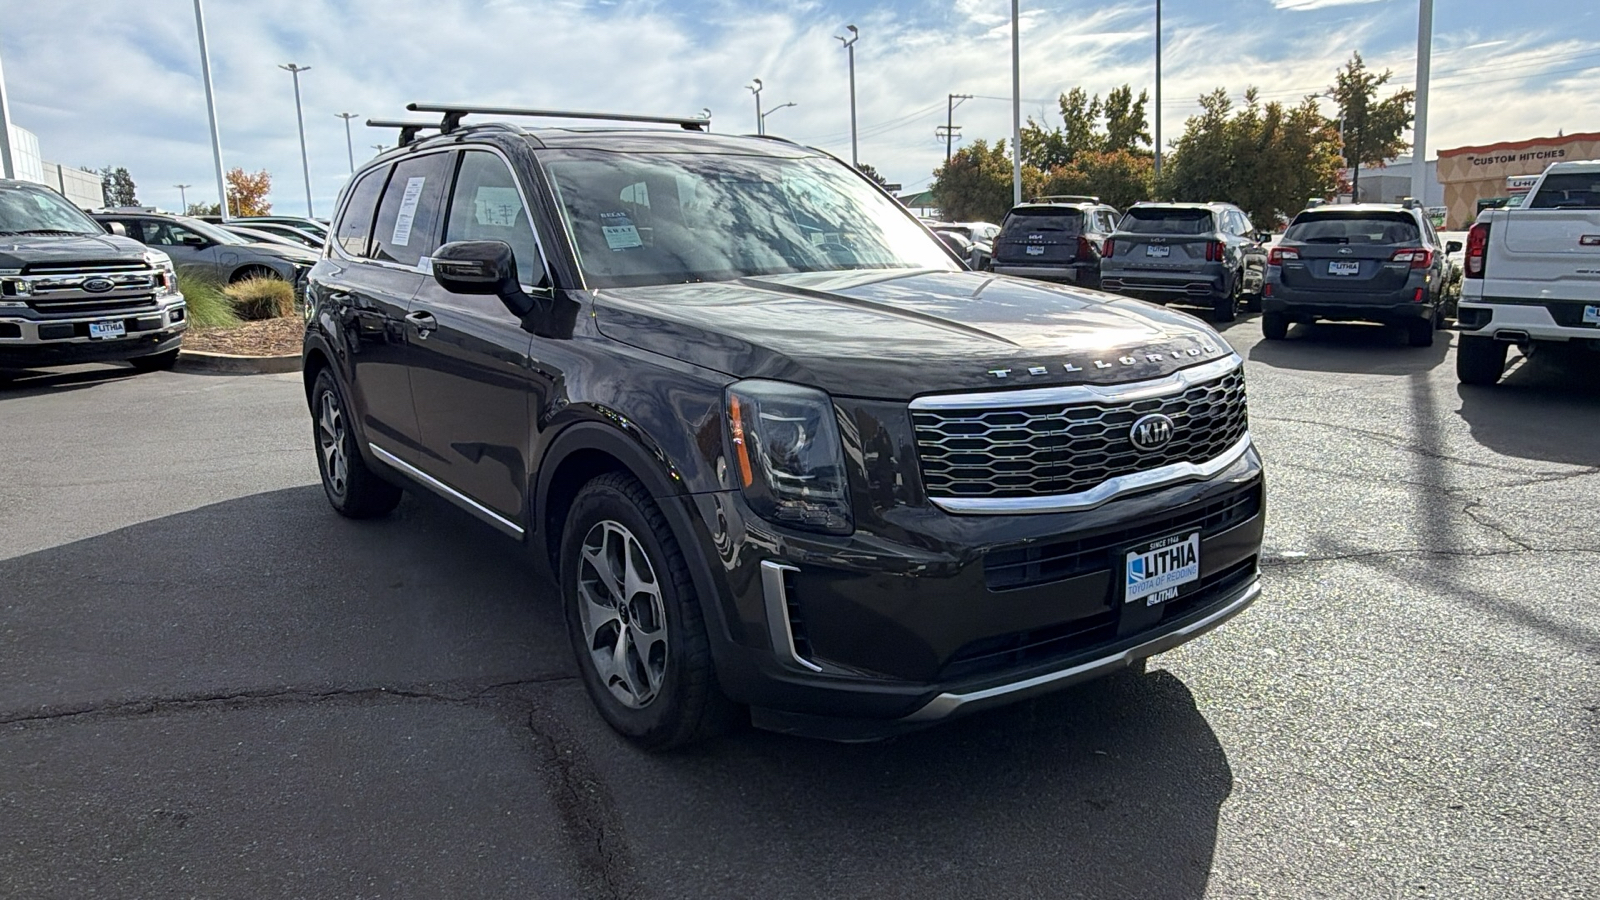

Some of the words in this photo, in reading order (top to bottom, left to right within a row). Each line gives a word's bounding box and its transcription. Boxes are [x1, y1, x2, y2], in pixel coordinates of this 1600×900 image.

[1473, 155, 1516, 166] CUSTOM
[1519, 149, 1565, 161] HITCHES
[98, 323, 124, 332] LITHIA
[987, 343, 1216, 378] TELLURIDE
[1139, 420, 1171, 445] KIA
[1149, 539, 1167, 550] SINCE
[1144, 542, 1197, 580] LITHIA
[1128, 580, 1154, 596] TOYOTA
[1155, 576, 1165, 587] OF
[1166, 565, 1197, 582] REDDING
[1154, 586, 1179, 604] LITHIA
